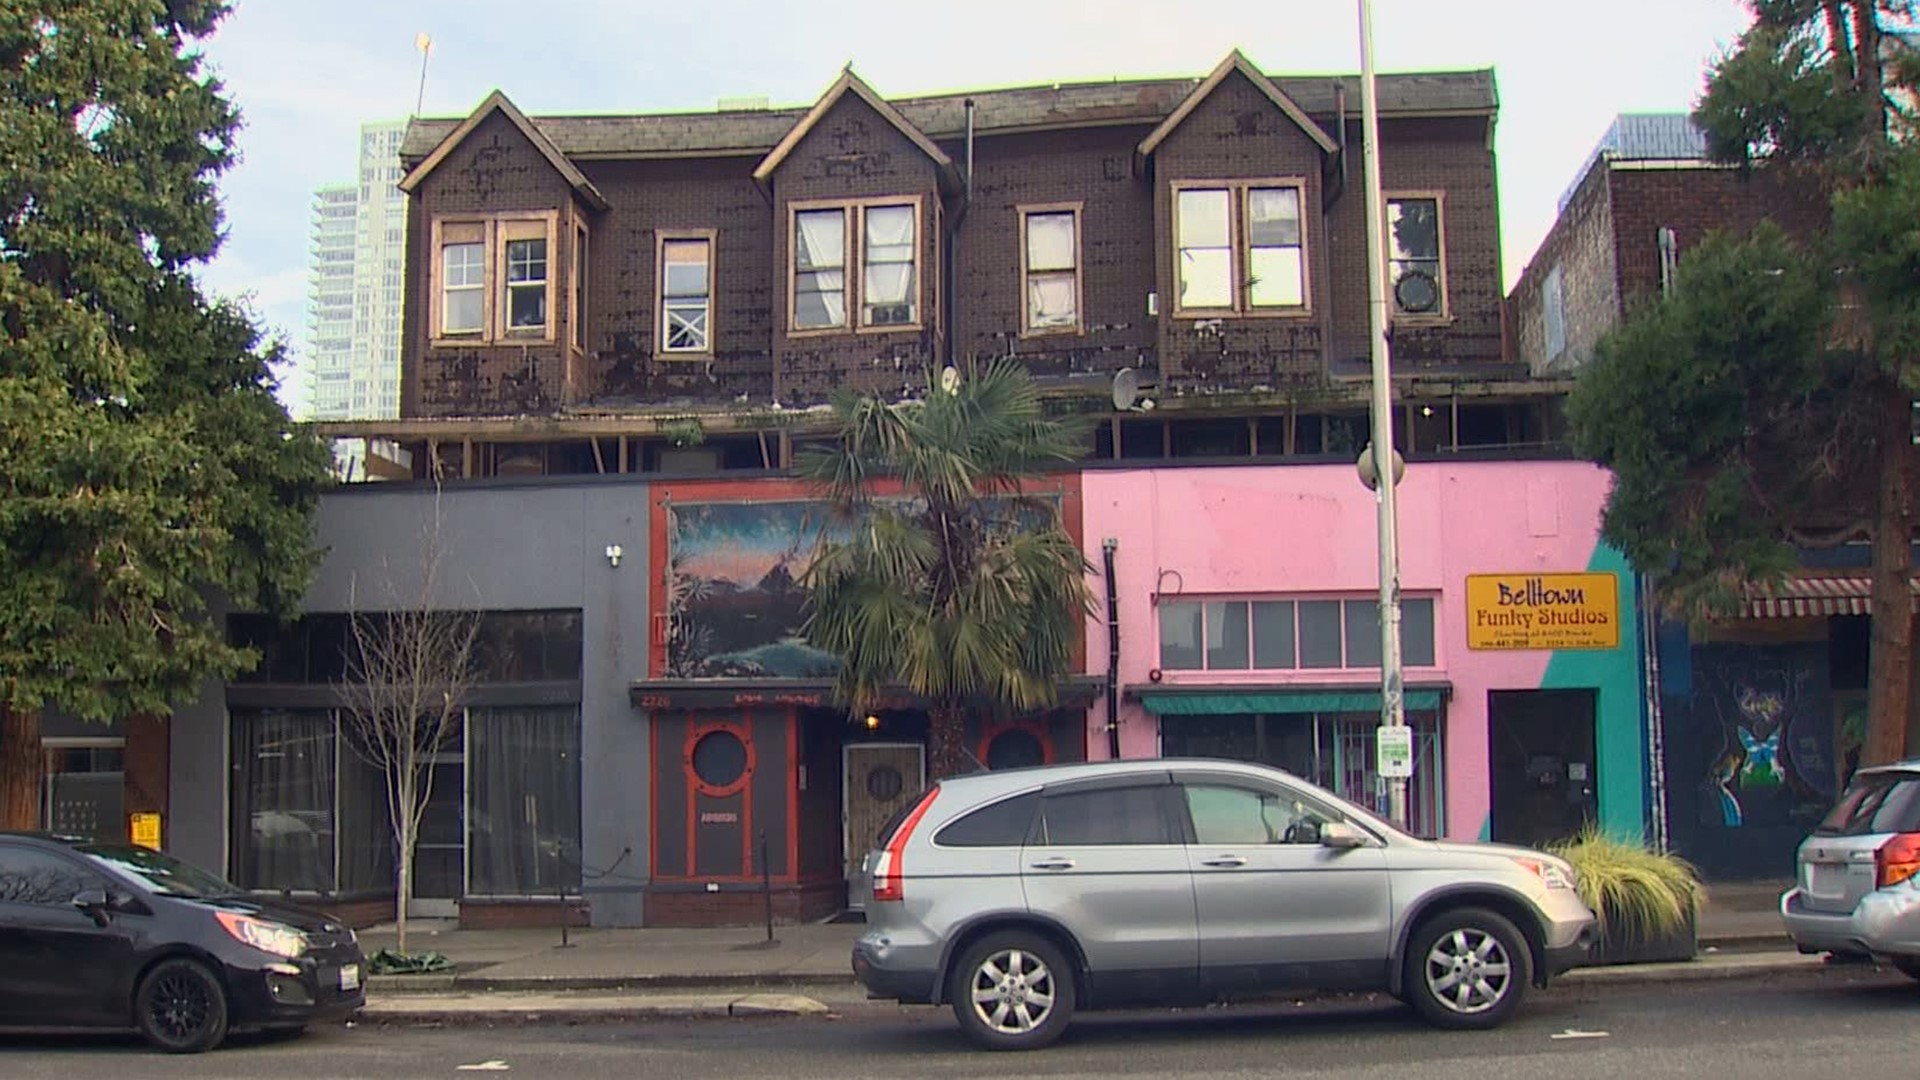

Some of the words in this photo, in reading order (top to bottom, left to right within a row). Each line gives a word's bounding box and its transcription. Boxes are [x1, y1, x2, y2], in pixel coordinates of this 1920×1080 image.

[1498, 578, 1584, 607] Belltown
[1476, 609, 1533, 628] Funky
[1538, 608, 1608, 625] Studios
